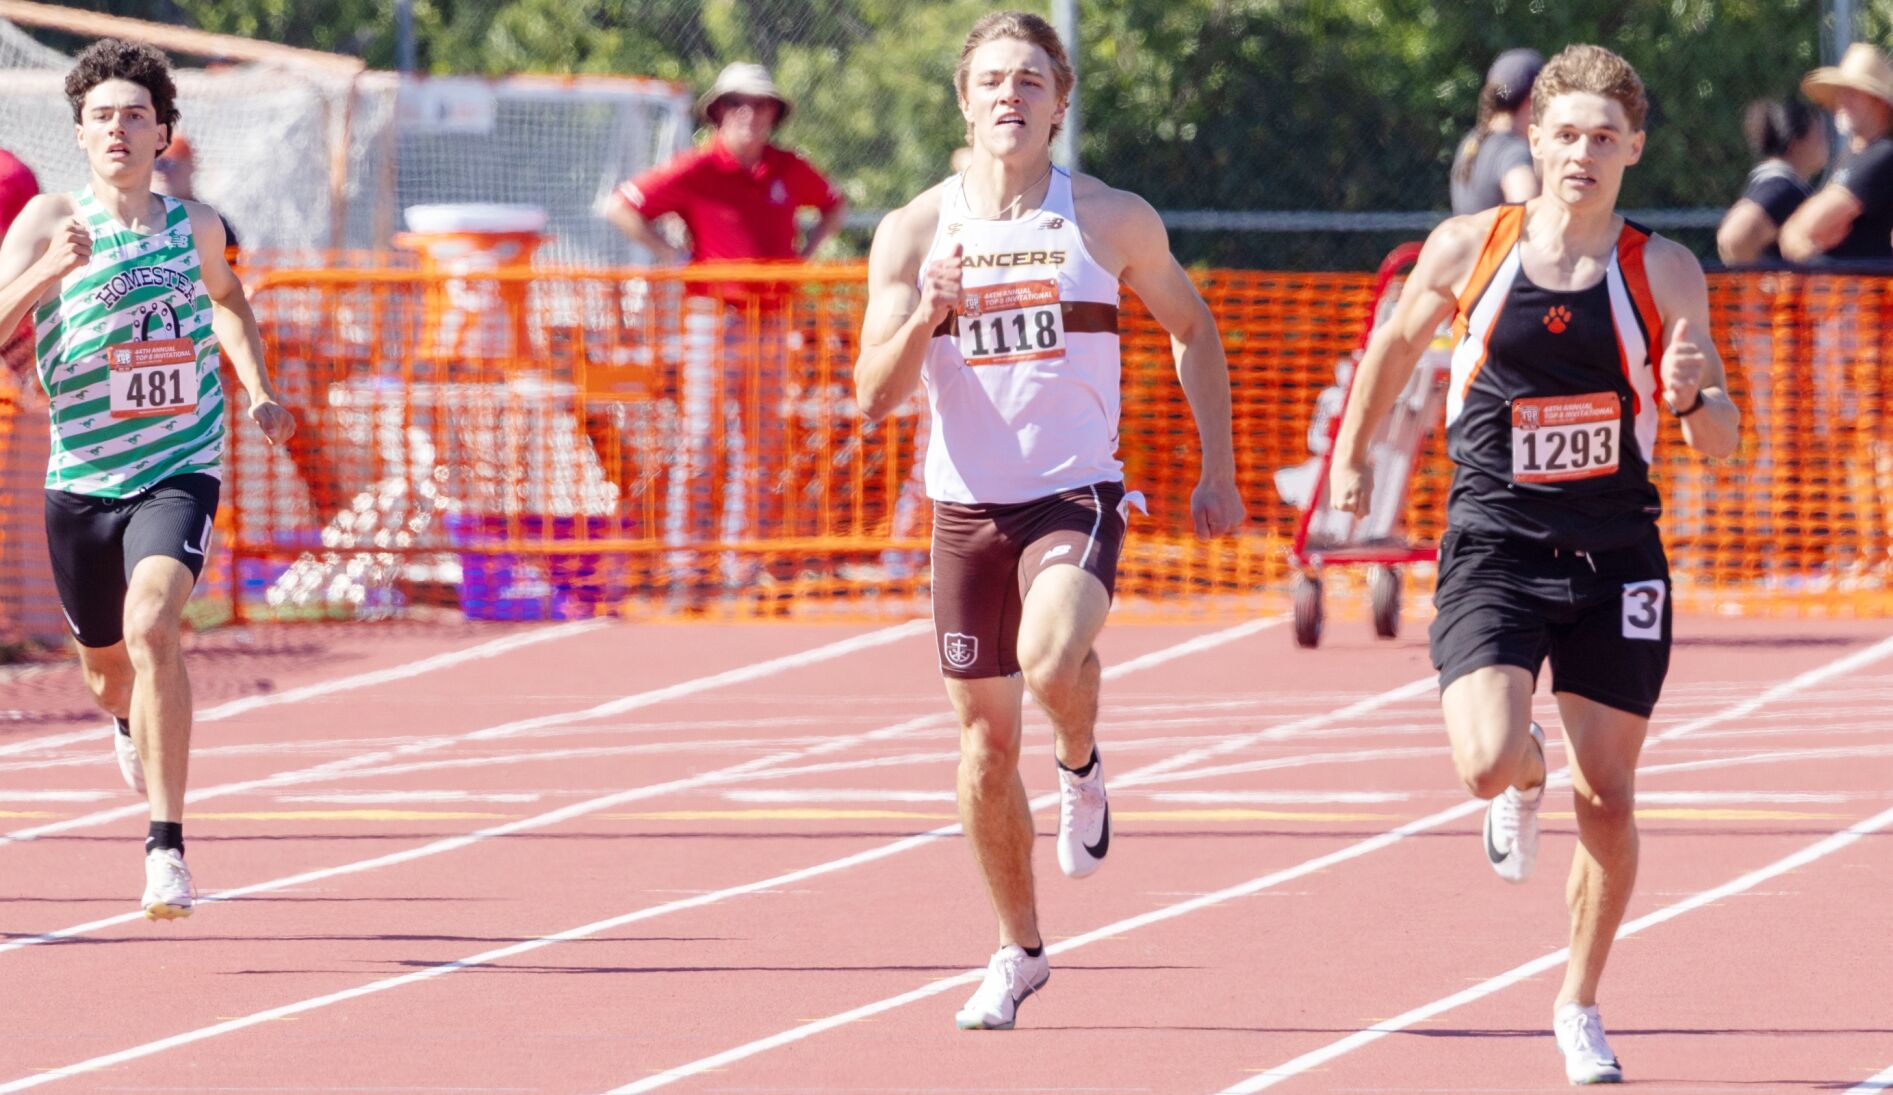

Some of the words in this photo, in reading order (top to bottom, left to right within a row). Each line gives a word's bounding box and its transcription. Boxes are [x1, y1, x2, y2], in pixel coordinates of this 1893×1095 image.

[961, 250, 1066, 269] ANCERS
[1002, 287, 1031, 296] ANNUAL
[1005, 291, 1053, 303] INVITATIONAL
[969, 310, 1057, 356] 1118
[153, 350, 191, 360] INVITATIONAL
[126, 368, 185, 408] 481
[1522, 426, 1613, 471] 1293
[1627, 586, 1659, 629] 3
